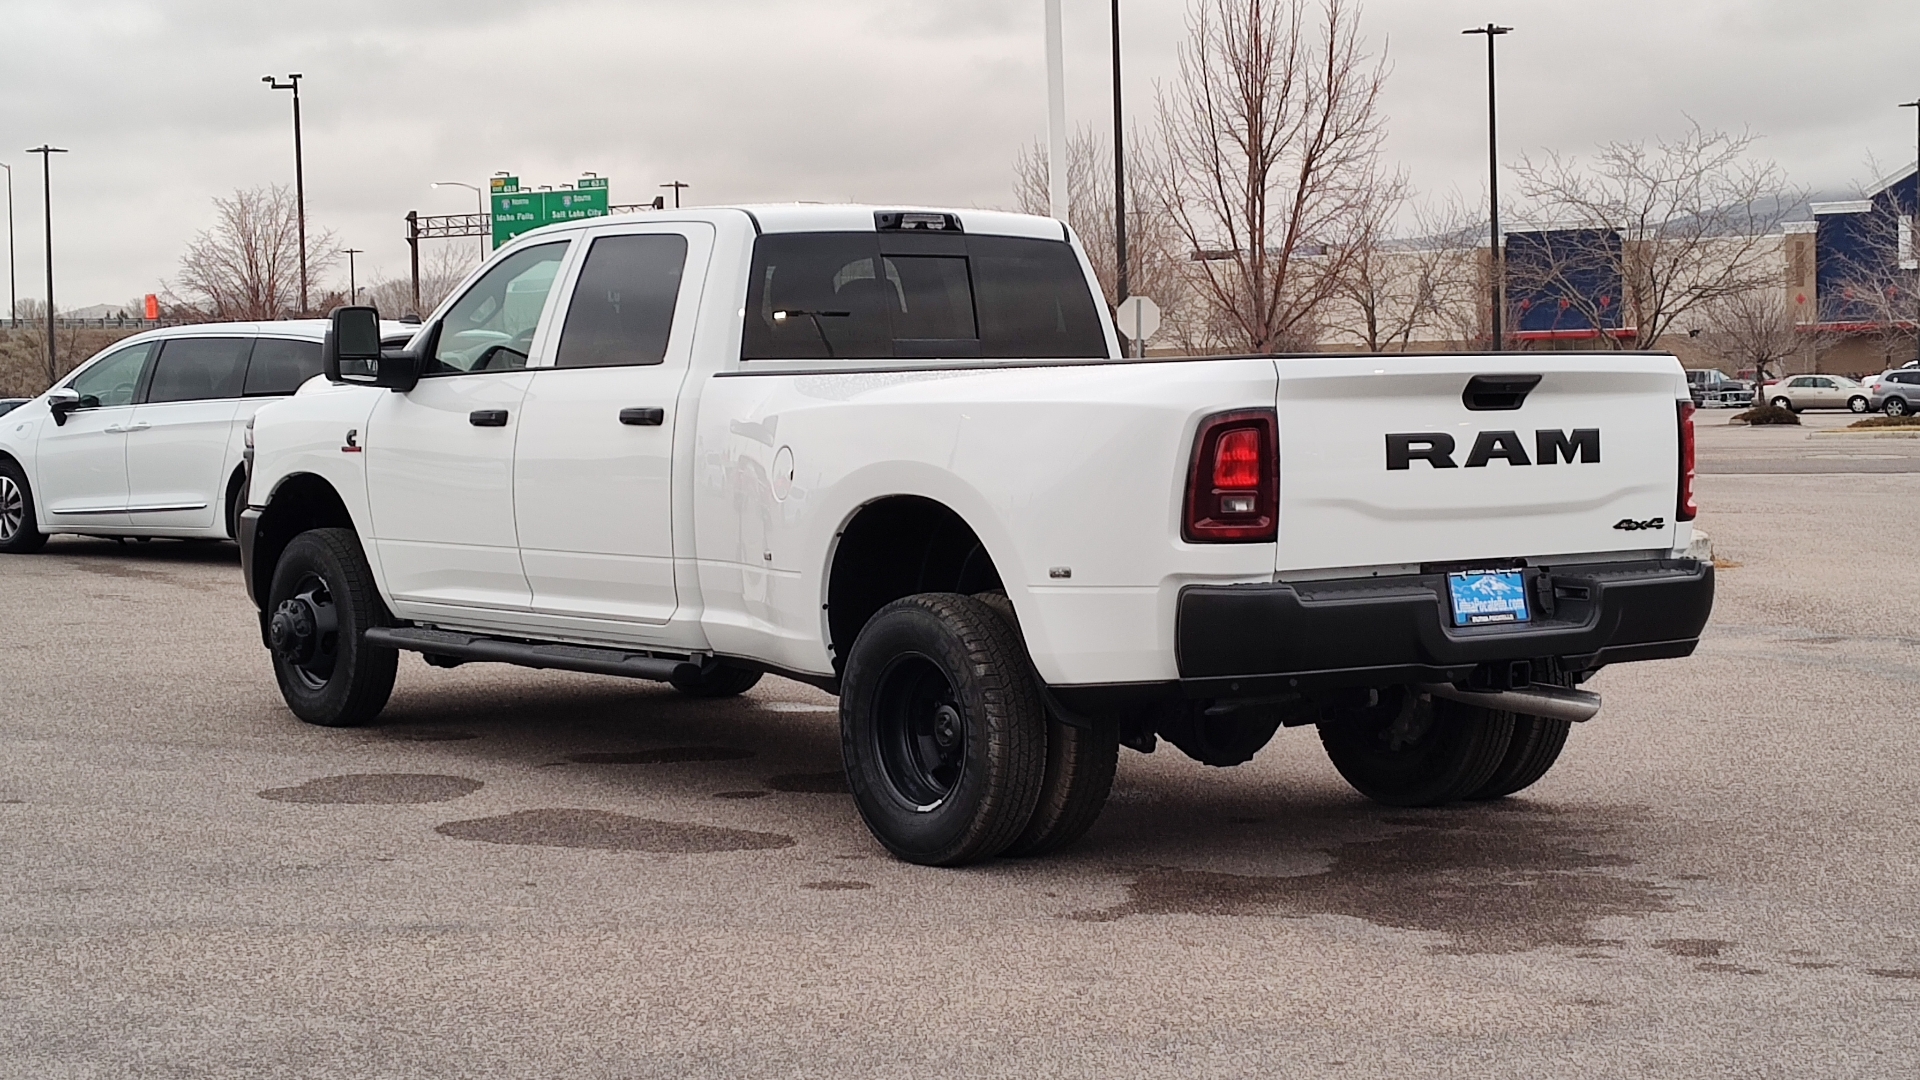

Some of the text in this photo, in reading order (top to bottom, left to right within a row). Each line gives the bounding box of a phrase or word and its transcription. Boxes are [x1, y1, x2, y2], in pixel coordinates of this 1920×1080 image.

[496, 212, 534, 222] Idaho Falls
[552, 208, 603, 219] Salt Lake City
[1385, 428, 1601, 471] RAM
[1612, 517, 1665, 531] 4x4
